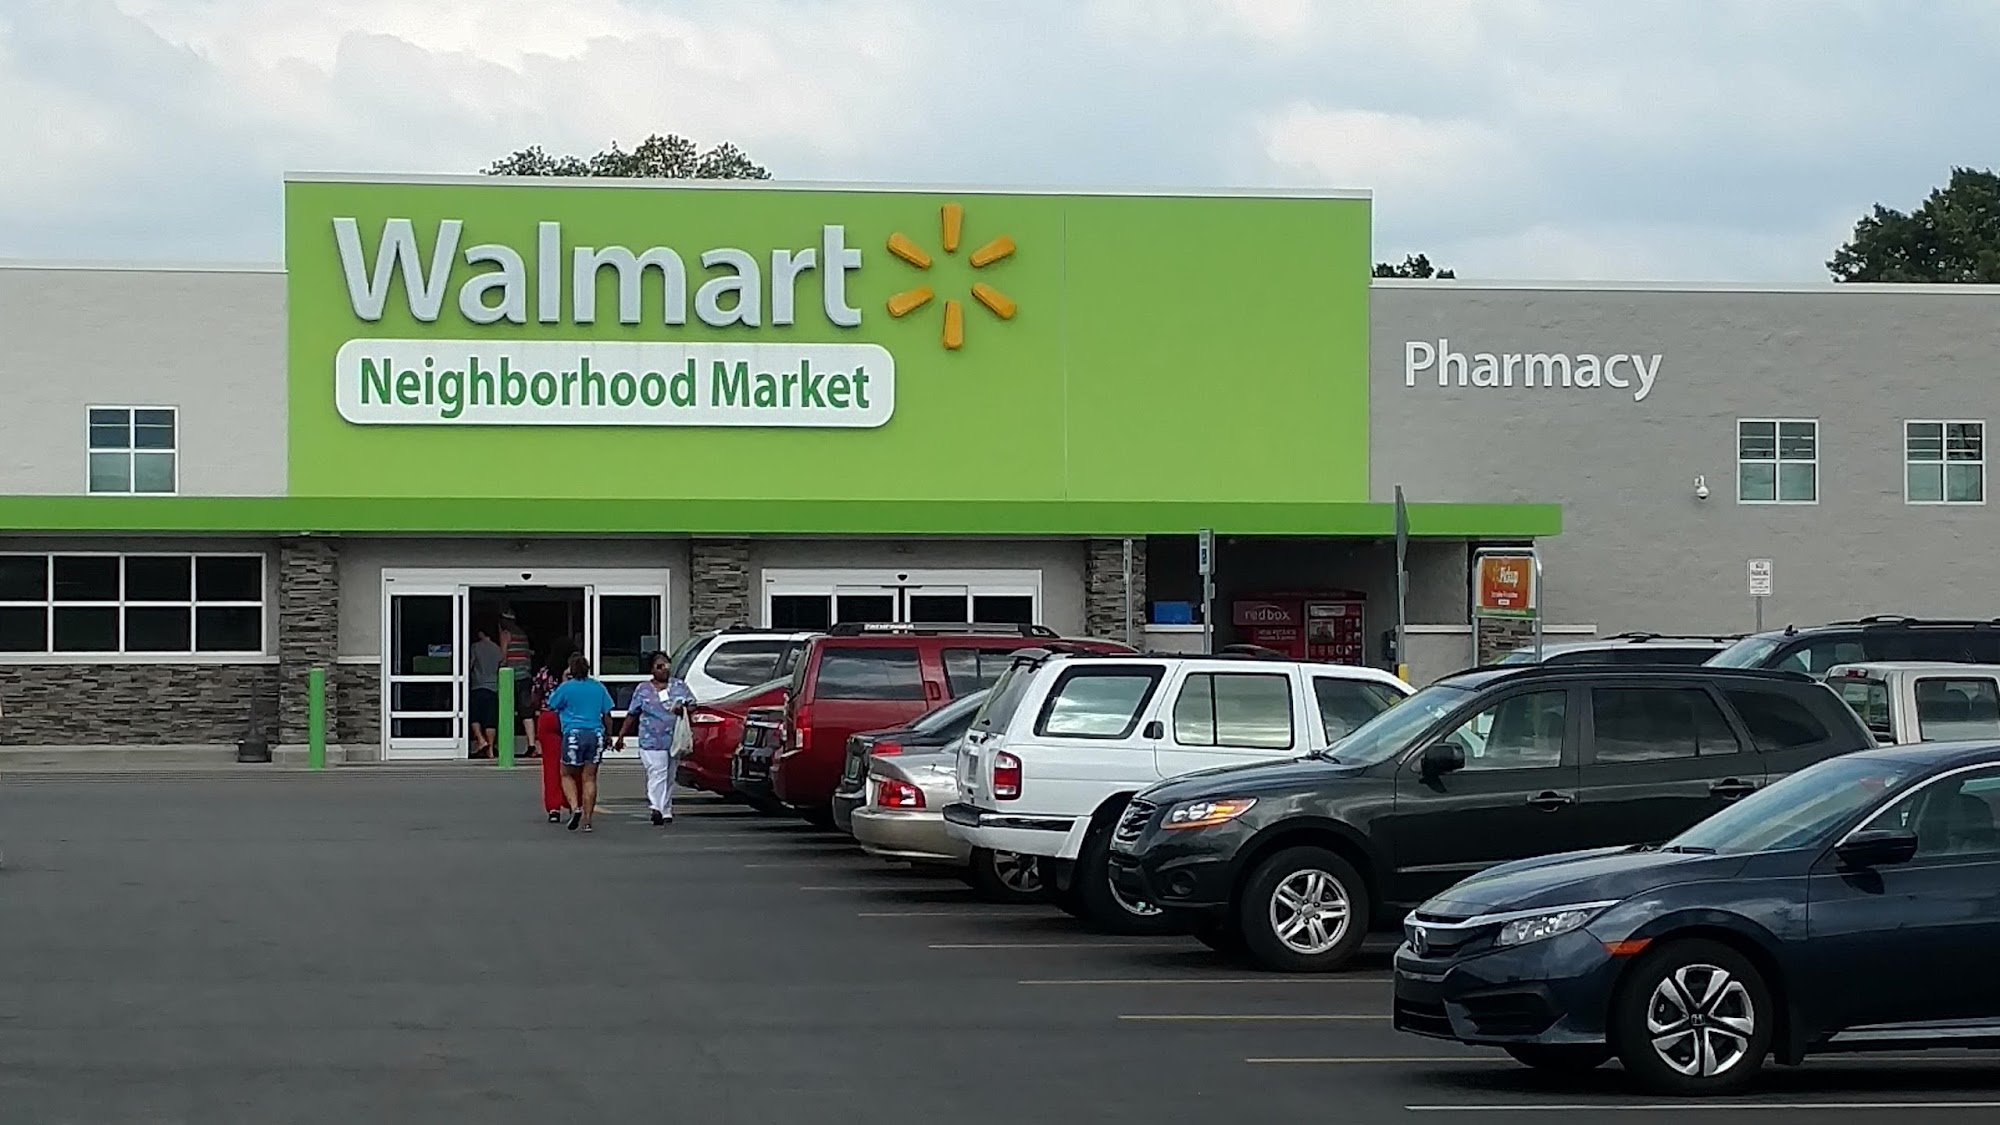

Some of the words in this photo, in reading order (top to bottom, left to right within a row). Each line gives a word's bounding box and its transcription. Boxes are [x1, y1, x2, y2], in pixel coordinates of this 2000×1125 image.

[333, 217, 862, 326] Walmart
[360, 357, 697, 418] Neighborhood
[710, 362, 869, 408] Market
[1404, 338, 1663, 401] Pharmacy
[1244, 608, 1291, 621] redbox
